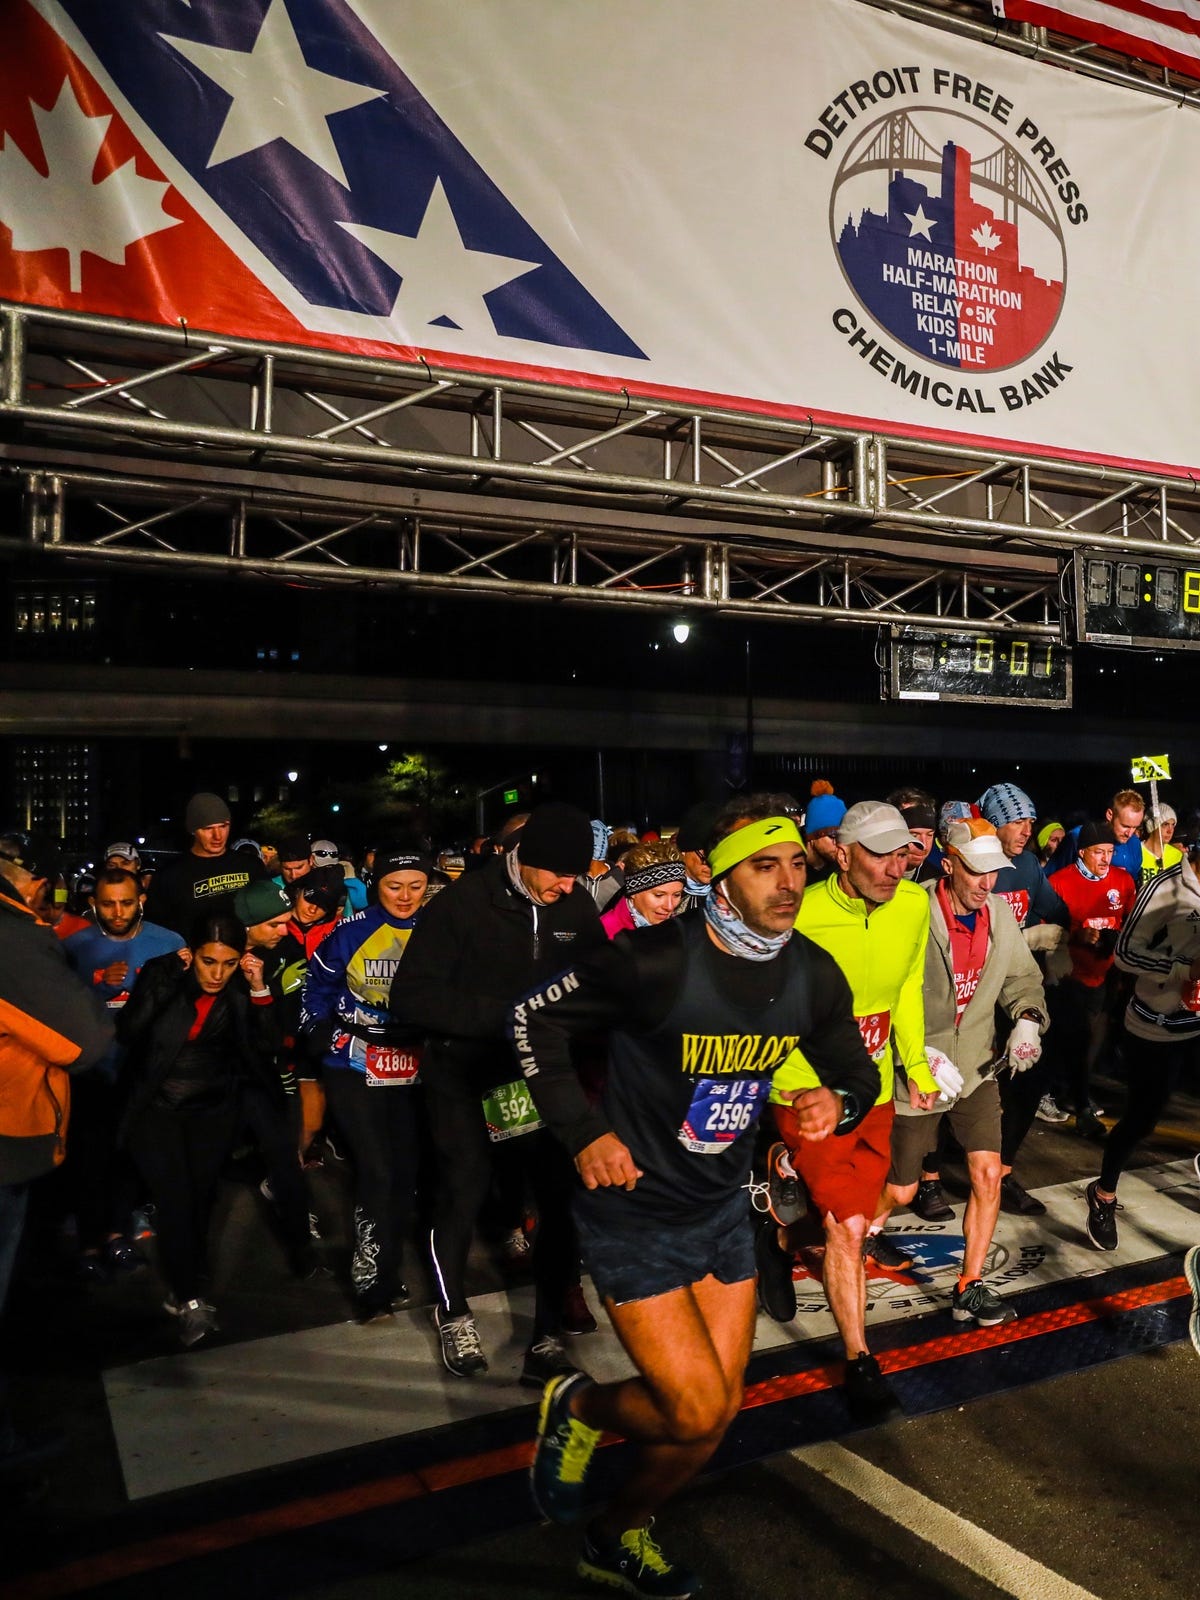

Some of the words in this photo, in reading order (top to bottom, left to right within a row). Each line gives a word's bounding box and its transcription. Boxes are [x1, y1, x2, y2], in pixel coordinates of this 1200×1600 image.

[804, 67, 920, 159] DETROIT
[934, 68, 1014, 125] FREE
[1016, 117, 1088, 225] PRESS
[907, 248, 998, 284] MARATHON
[882, 263, 1021, 310] HALF-MARATHON
[912, 291, 962, 318] RELAY
[976, 307, 997, 325] 5K
[917, 314, 955, 338] KIDS
[960, 324, 994, 345] RUN
[832, 308, 996, 413] CHEMICAL
[999, 351, 1074, 411] BANK
[929, 337, 985, 364] 1-MILE
[211, 873, 248, 886] INFINITE
[514, 972, 580, 1078] MARATHON
[376, 1055, 415, 1072] 41801
[705, 1102, 753, 1131] 2596
[985, 1245, 1046, 1287] DETROIT
